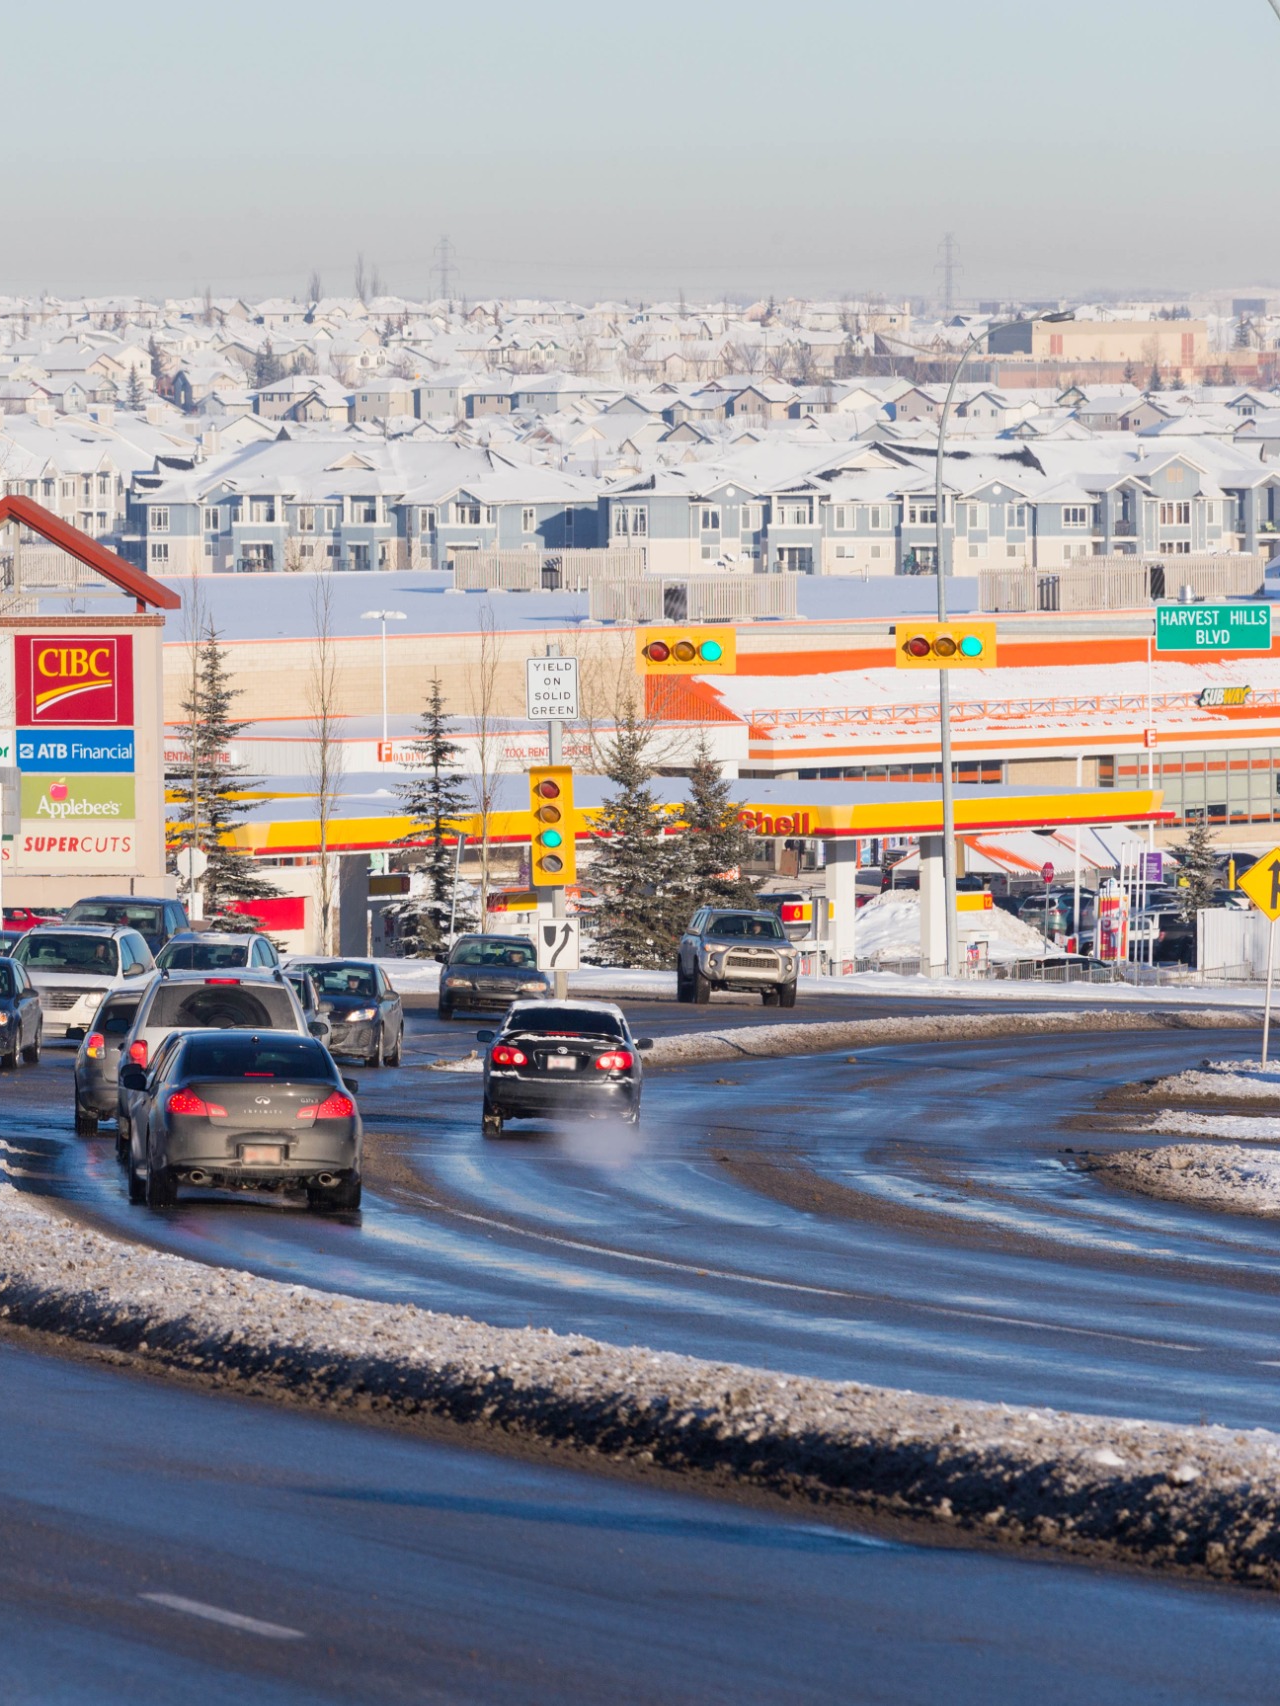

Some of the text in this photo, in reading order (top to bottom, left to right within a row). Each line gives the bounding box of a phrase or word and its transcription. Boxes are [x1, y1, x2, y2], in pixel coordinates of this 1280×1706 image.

[1160, 610, 1267, 626] HARVEST HILLS
[1196, 629, 1230, 645] BLVD
[38, 648, 110, 677] CIBC
[533, 662, 572, 671] YIELD
[544, 677, 561, 686] ON
[534, 691, 571, 701] SOLID
[1200, 685, 1251, 706] SUBWAY
[531, 706, 574, 715] GREEN
[1147, 730, 1157, 747] E
[37, 743, 133, 759] ATB Financial
[381, 743, 392, 761] F
[528, 747, 549, 757] RENT
[36, 795, 121, 819] Applebee's
[737, 810, 810, 835] Shell
[23, 836, 131, 853] SUPERCUTS
[793, 907, 801, 919] 6
